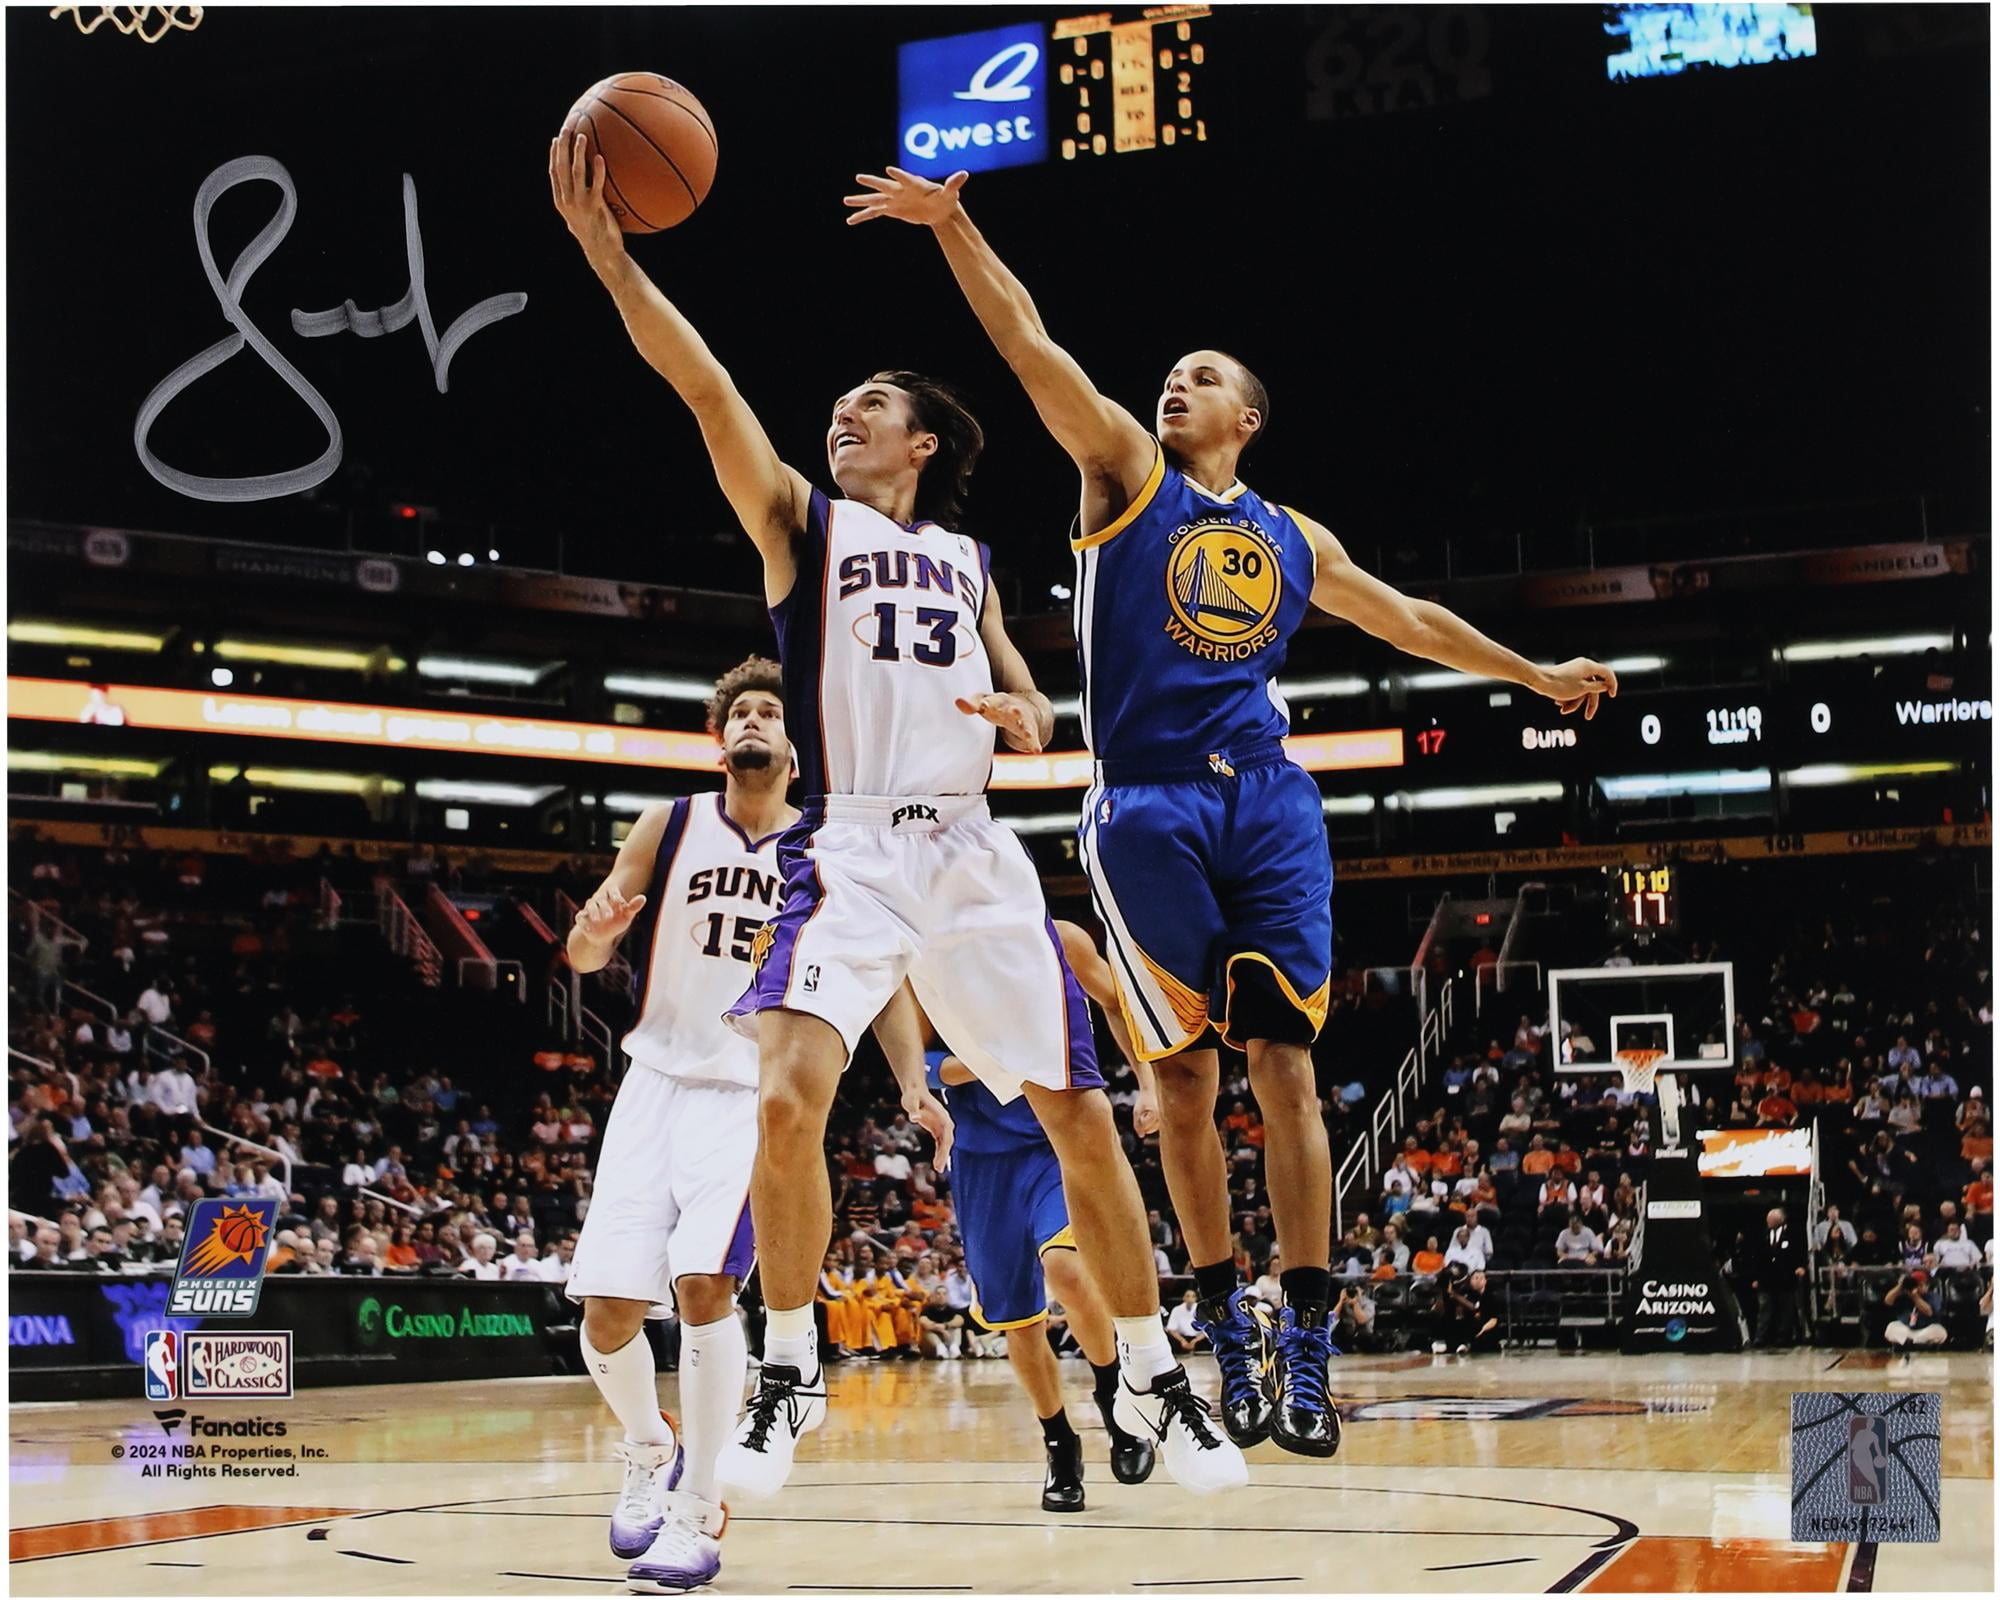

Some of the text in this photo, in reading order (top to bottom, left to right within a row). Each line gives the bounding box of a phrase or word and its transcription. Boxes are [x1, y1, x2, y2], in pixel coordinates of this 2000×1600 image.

[904, 115, 1031, 159] Qwest
[1239, 519, 1284, 557] STATE
[1222, 548, 1262, 579] 30
[839, 551, 977, 616] SUNS
[872, 602, 958, 667] 13
[1164, 615, 1278, 662] WARRIORS
[1811, 703, 1831, 733] 0
[1896, 698, 1992, 725] Warriors
[1417, 729, 1446, 754] 17
[1641, 714, 1661, 744] 0
[891, 804, 940, 828] PHX
[1633, 892, 1666, 926] 17
[702, 912, 764, 963] 15
[1642, 1280, 1708, 1298] CASINO
[386, 1305, 534, 1338] CASINO ARIZONA
[1635, 1298, 1716, 1315] ARIZONA
[1853, 1486, 1873, 1500] NBA
